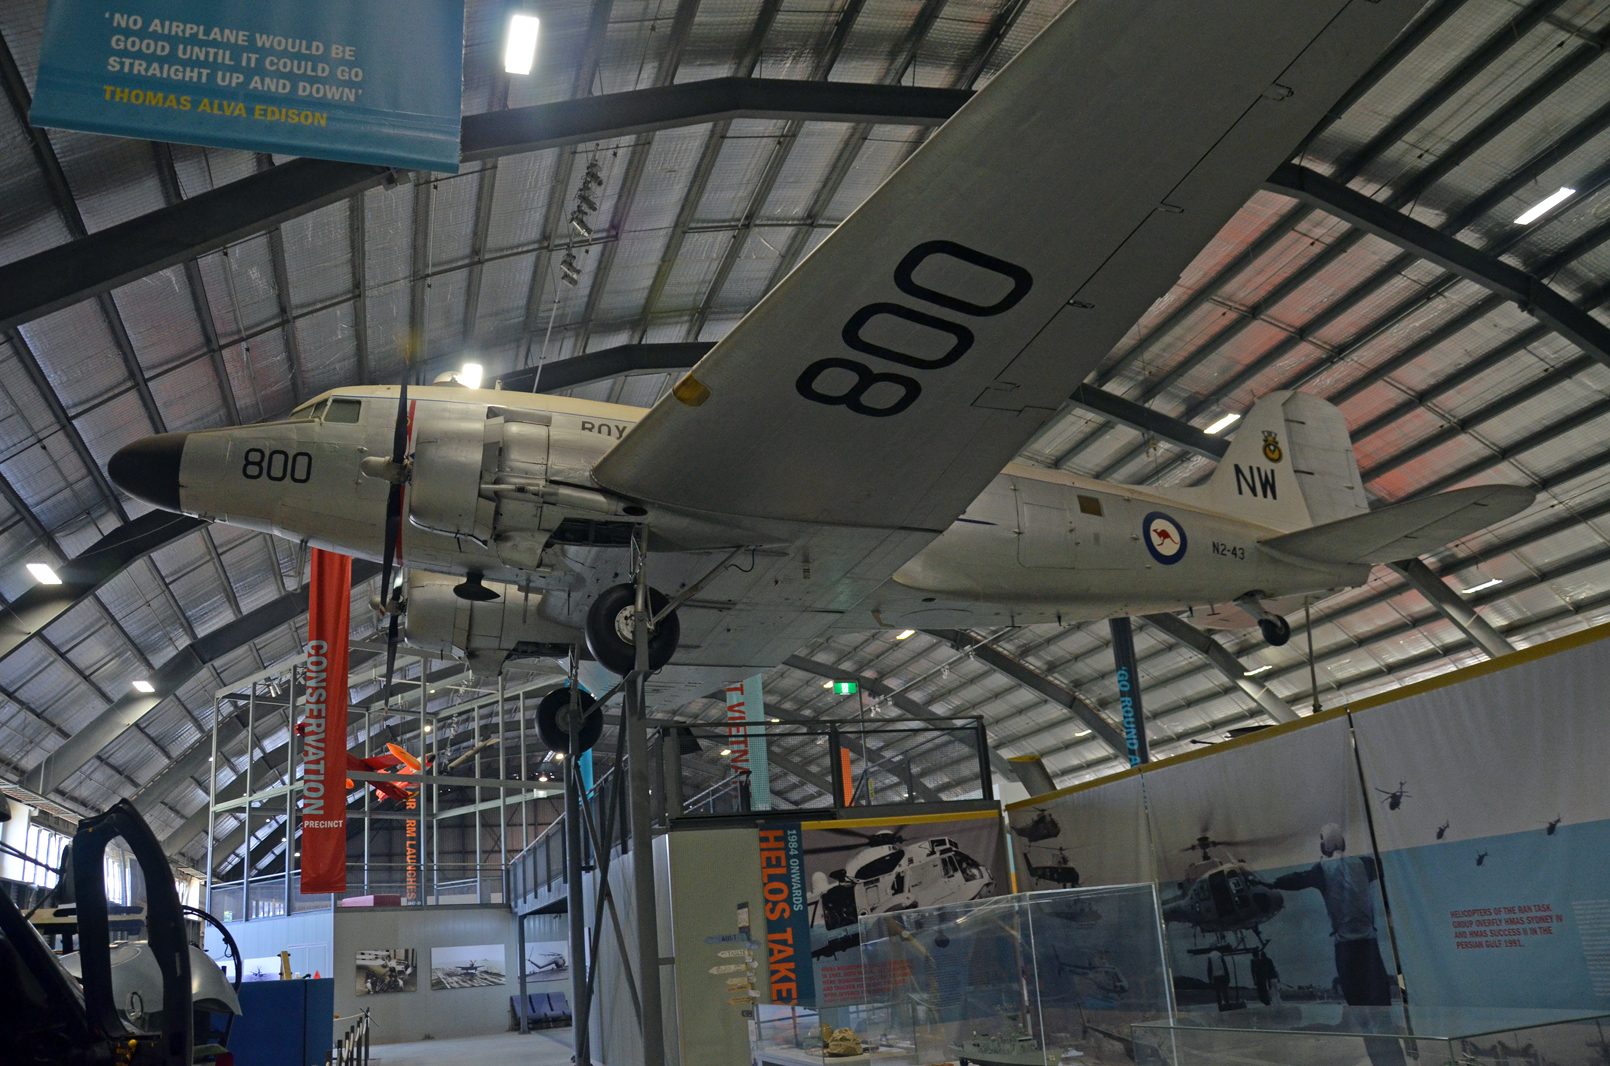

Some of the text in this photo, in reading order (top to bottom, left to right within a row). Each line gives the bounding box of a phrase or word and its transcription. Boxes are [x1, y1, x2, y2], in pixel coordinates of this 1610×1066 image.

[111, 34, 363, 82] GOOD UNTIL IT COULD GO
[148, 18, 249, 46] AIRPLANE
[255, 33, 324, 55] WOULD
[331, 44, 356, 60] BE
[107, 56, 211, 83] STRAIGHT
[217, 70, 244, 87] UP
[249, 75, 291, 94] AND
[103, 85, 327, 127] THOMAS ALVA EDISON
[795, 240, 1033, 417] 800
[242, 447, 313, 484] 800
[1233, 463, 1277, 500] NW
[1212, 541, 1245, 560] N2-43
[302, 639, 328, 815] CONSERVATION
[1120, 697, 1139, 750] ROUND
[727, 701, 752, 798] VIETNA
[1128, 755, 1141, 768] A
[304, 819, 344, 829] PRECINCT
[406, 841, 417, 899] LAUNCHES
[759, 829, 791, 920] HELOS
[787, 829, 803, 911] 1984 ONWARDS
[1450, 903, 1552, 918] HELICOPTERS OF THE RAN TASK
[1452, 914, 1563, 928] GROUP OVERFLY HMAS SYDNEY IV
[1454, 931, 1468, 939] AND
[1469, 930, 1488, 938] HMAS
[1490, 928, 1521, 937] SUCCESS
[1530, 927, 1538, 935] IN
[1538, 926, 1553, 935] THE
[1456, 938, 1524, 949] PERSIAN GULF 1991.
[767, 927, 798, 1002] TAKE
